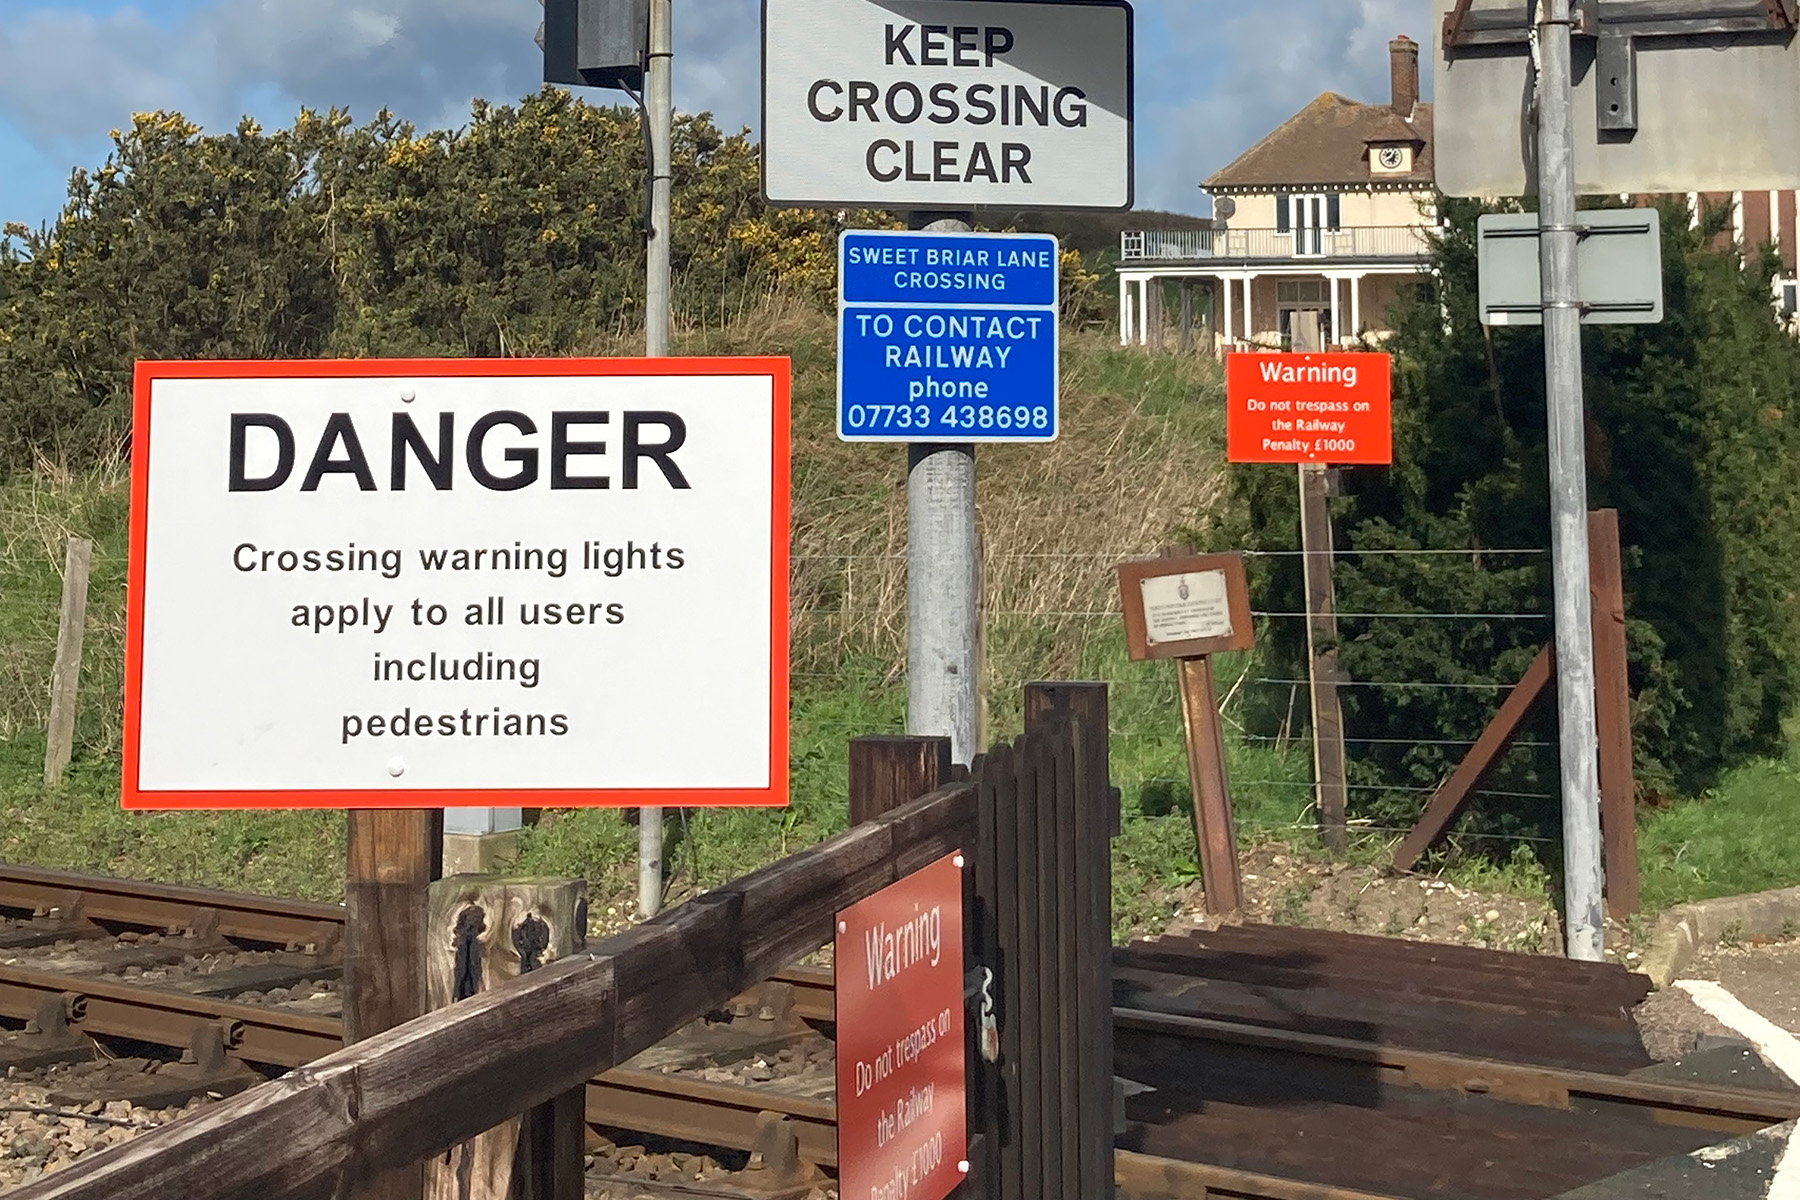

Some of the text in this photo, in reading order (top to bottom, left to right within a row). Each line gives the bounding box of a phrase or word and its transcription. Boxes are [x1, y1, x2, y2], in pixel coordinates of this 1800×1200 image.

[884, 23, 1014, 68] KEEP
[807, 78, 1088, 128] CROSSING
[866, 139, 1032, 184] CLEAR
[848, 247, 1050, 268] SWEET BRIAR LANE
[894, 271, 1006, 291] CROSSING
[856, 314, 1042, 340] TO CONTACT
[885, 345, 1012, 368] RAILWAY
[1259, 361, 1357, 388] Warning
[909, 376, 988, 402] phone
[1247, 398, 1370, 414] Do not trespass on
[848, 404, 1049, 430] 07733 438698
[1271, 418, 1346, 434] the Railway
[228, 410, 692, 493] DANGER
[1262, 438, 1355, 453] Penalty £1000
[233, 540, 685, 579] Crossing warning lights
[291, 596, 625, 634] apply to all users
[374, 651, 540, 689] including
[342, 706, 569, 745] pedestrians
[865, 903, 941, 990] Warning
[856, 1007, 951, 1097] Do not trespass on
[877, 1081, 935, 1148] the Railway
[912, 1131, 943, 1186] £1000
